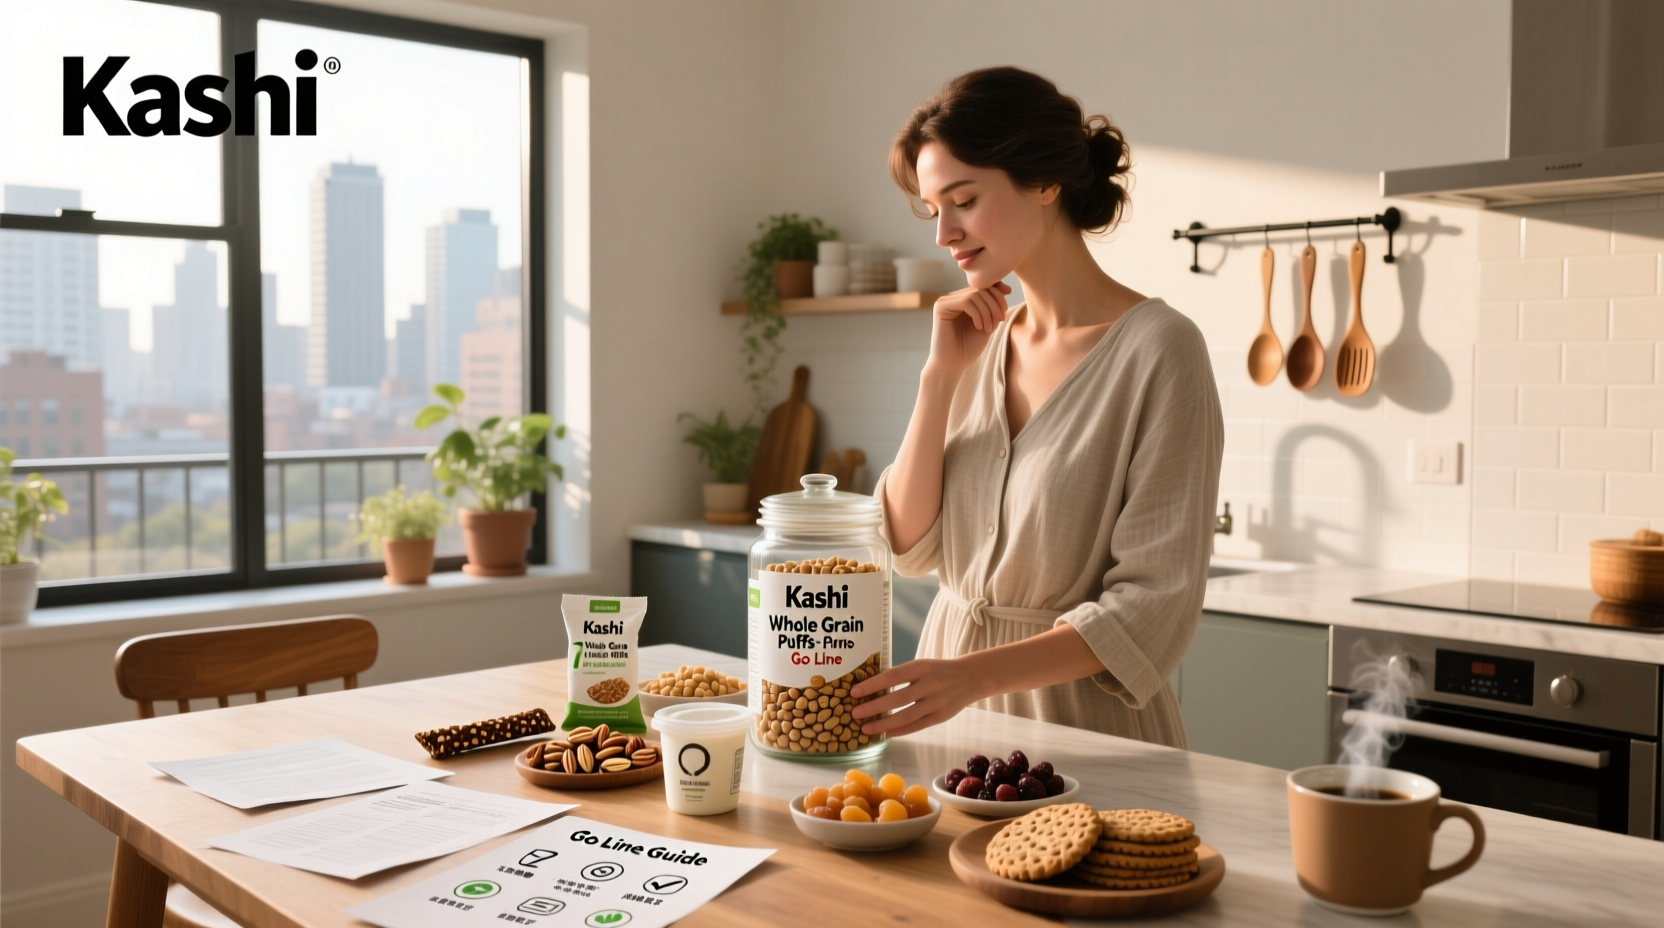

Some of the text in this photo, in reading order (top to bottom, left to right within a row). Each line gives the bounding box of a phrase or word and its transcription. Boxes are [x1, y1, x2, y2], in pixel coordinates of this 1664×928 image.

[786, 584, 849, 609] Kashi
[583, 620, 624, 635] Kashi
[769, 615, 864, 632] Whole Grain
[791, 652, 843, 666] Go Line
[570, 830, 708, 866] Go Line Guide
